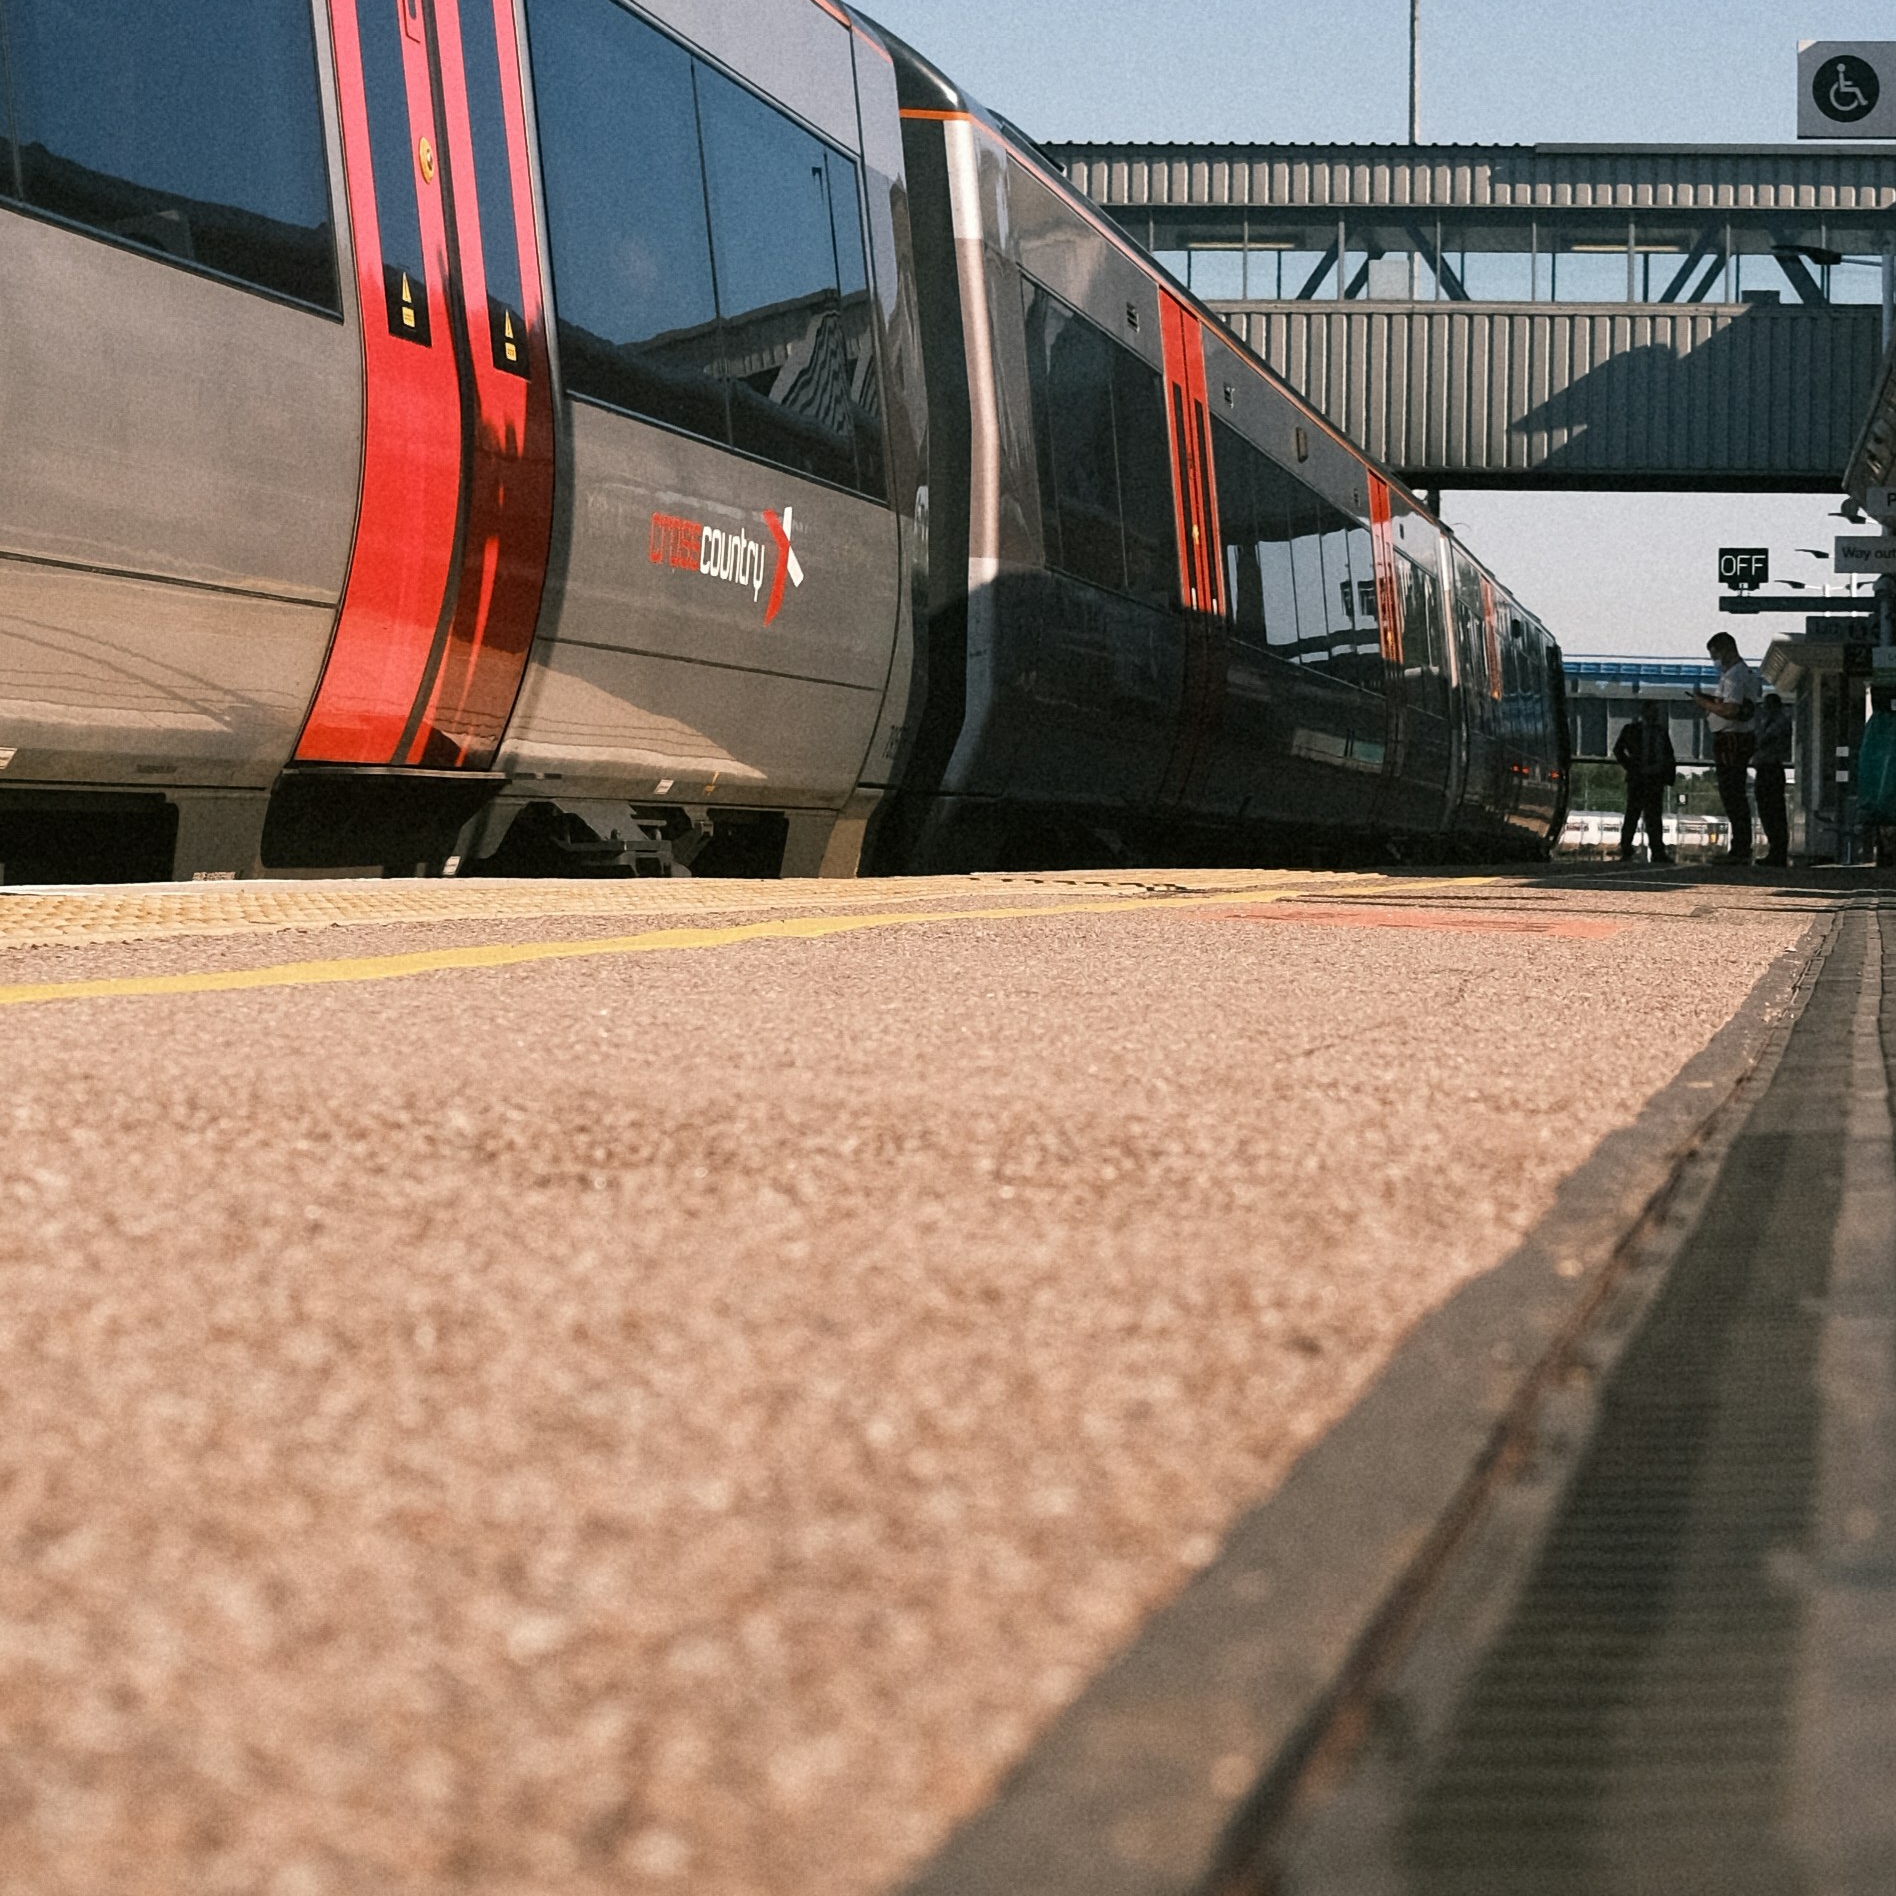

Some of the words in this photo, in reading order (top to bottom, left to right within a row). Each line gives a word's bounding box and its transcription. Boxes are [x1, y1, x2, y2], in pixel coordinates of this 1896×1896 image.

[1842, 546, 1869, 561] Way
[1874, 547, 1896, 559] out
[1720, 554, 1766, 577] OFF
